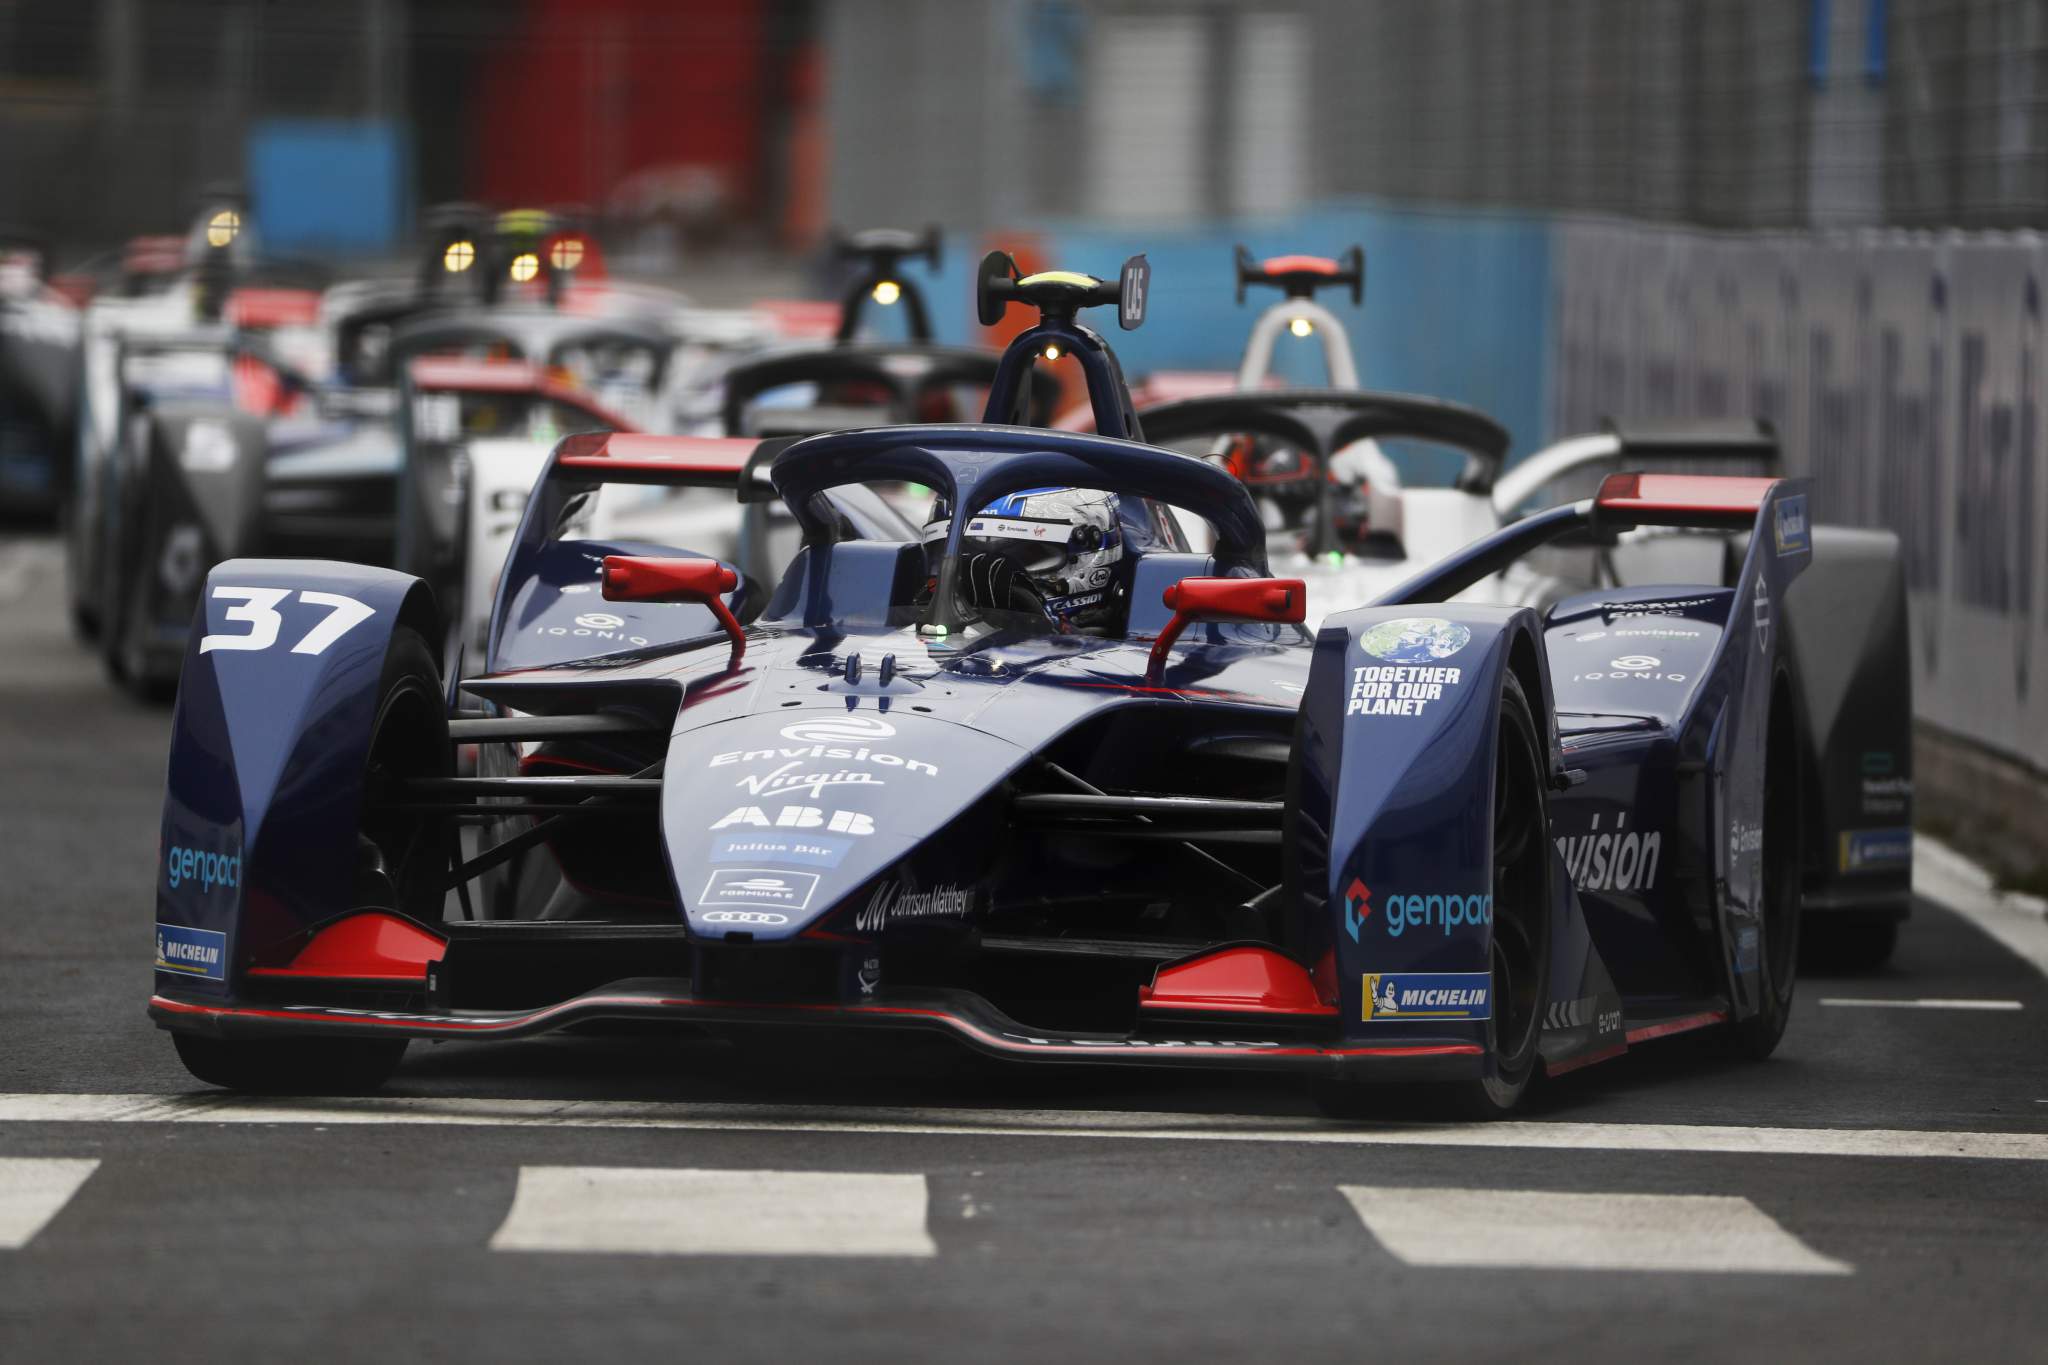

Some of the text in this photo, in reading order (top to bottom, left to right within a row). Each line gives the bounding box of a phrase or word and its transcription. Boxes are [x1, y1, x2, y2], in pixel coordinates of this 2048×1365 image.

[199, 586, 377, 656] 37
[537, 626, 648, 647] IQONIQ
[1354, 666, 1461, 685] TOGETHER
[1573, 671, 1686, 682] IQONIQ
[1350, 682, 1443, 700] FOR OUR
[1347, 699, 1428, 716] PLANET
[708, 745, 939, 777] Envision
[735, 761, 885, 798] Virgin
[708, 805, 875, 836] ABB
[727, 842, 787, 853] Julius
[1553, 811, 1661, 891] vision
[719, 889, 783, 899] FORMULA
[890, 886, 931, 916] Johnson
[931, 881, 968, 919] Matthey
[166, 941, 219, 964] MICHELIN
[1400, 989, 1487, 1006] MICHELIN
